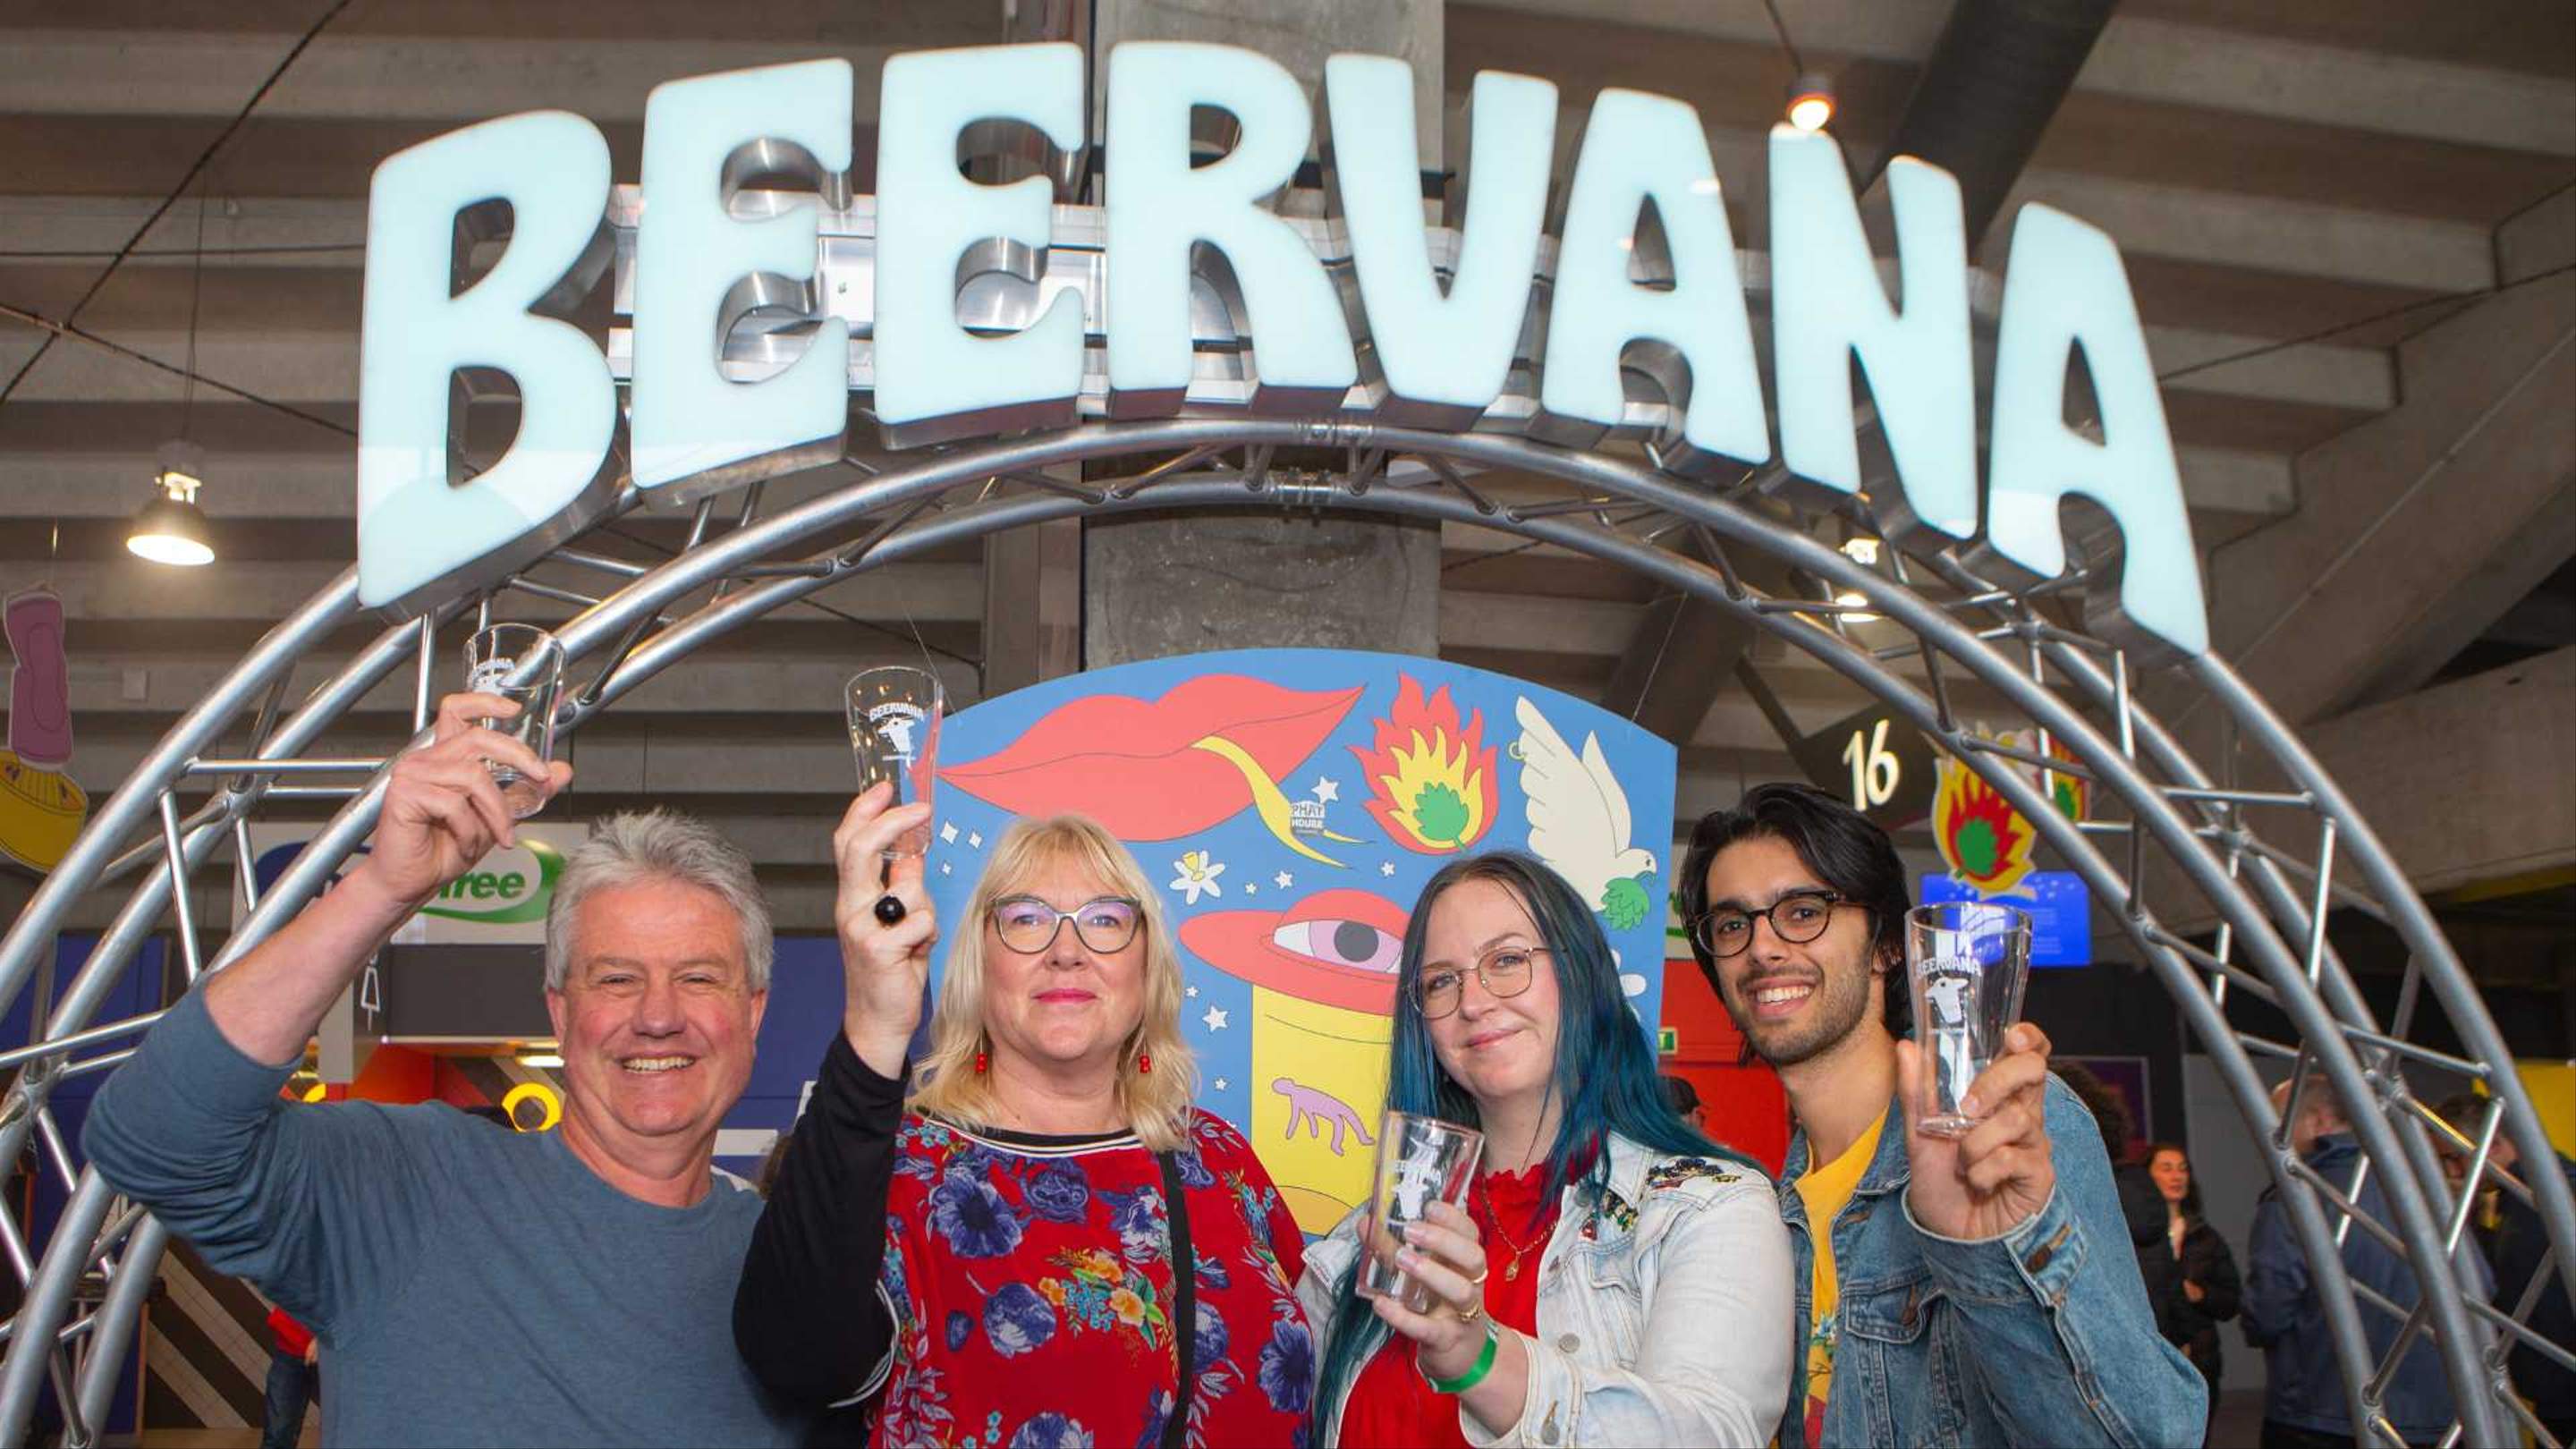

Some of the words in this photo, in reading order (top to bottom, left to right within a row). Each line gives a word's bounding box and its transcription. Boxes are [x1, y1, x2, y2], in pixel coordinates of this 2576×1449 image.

[358, 41, 2207, 658] BEERVANA
[1292, 803, 1324, 817] PHAT
[1843, 718, 1900, 812] 16
